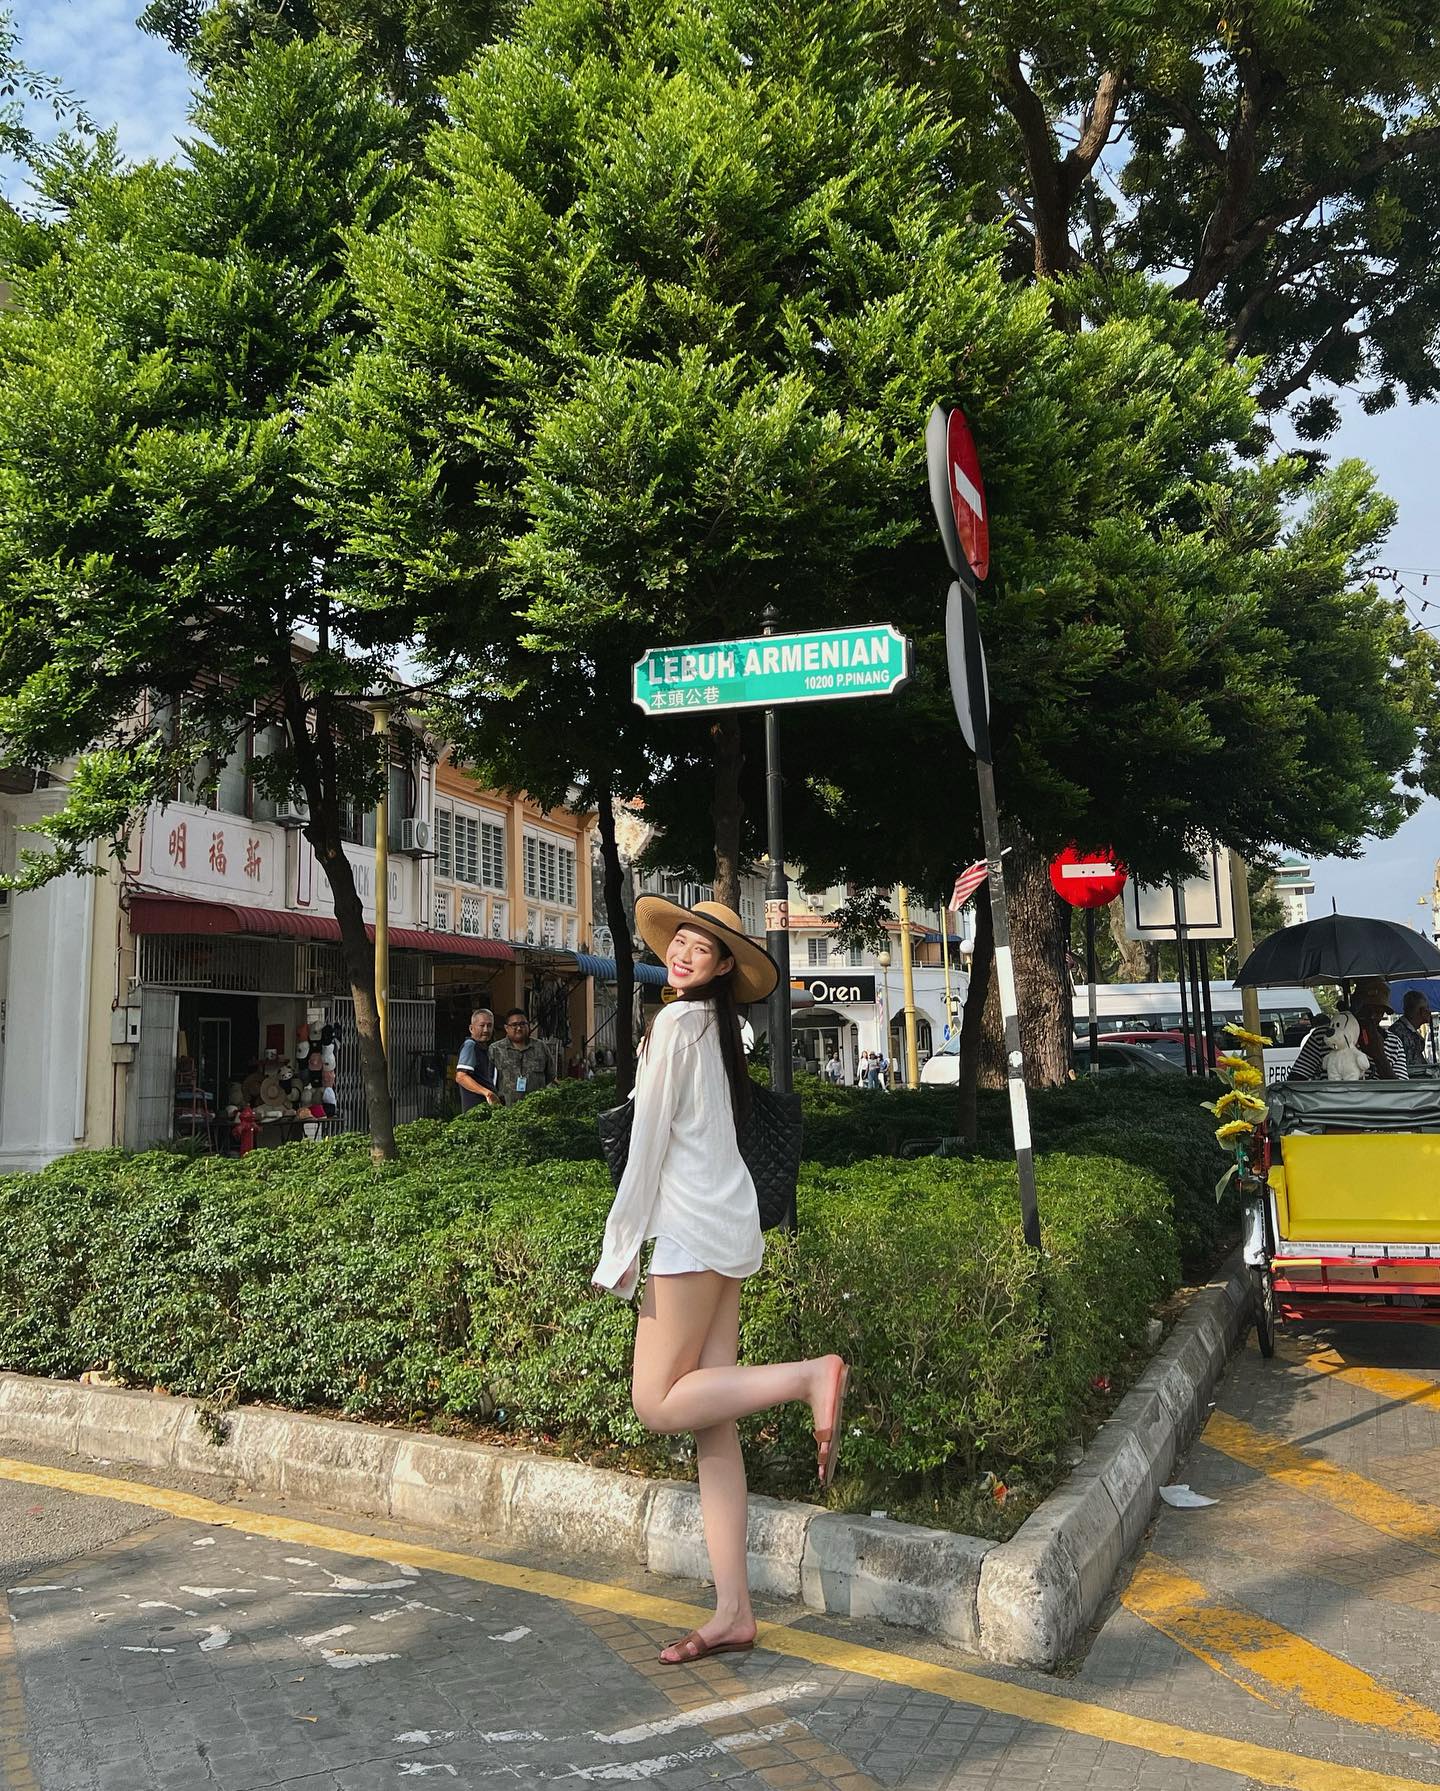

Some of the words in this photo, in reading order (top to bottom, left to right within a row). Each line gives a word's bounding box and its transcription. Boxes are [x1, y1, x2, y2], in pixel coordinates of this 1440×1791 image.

[648, 651, 735, 686] LEBUH
[742, 636, 889, 677] ARMENIAN
[804, 674, 834, 690] 10200
[836, 669, 890, 687] P.PINANG
[650, 686, 720, 709] 本頭公巷
[809, 980, 861, 1001] Oren
